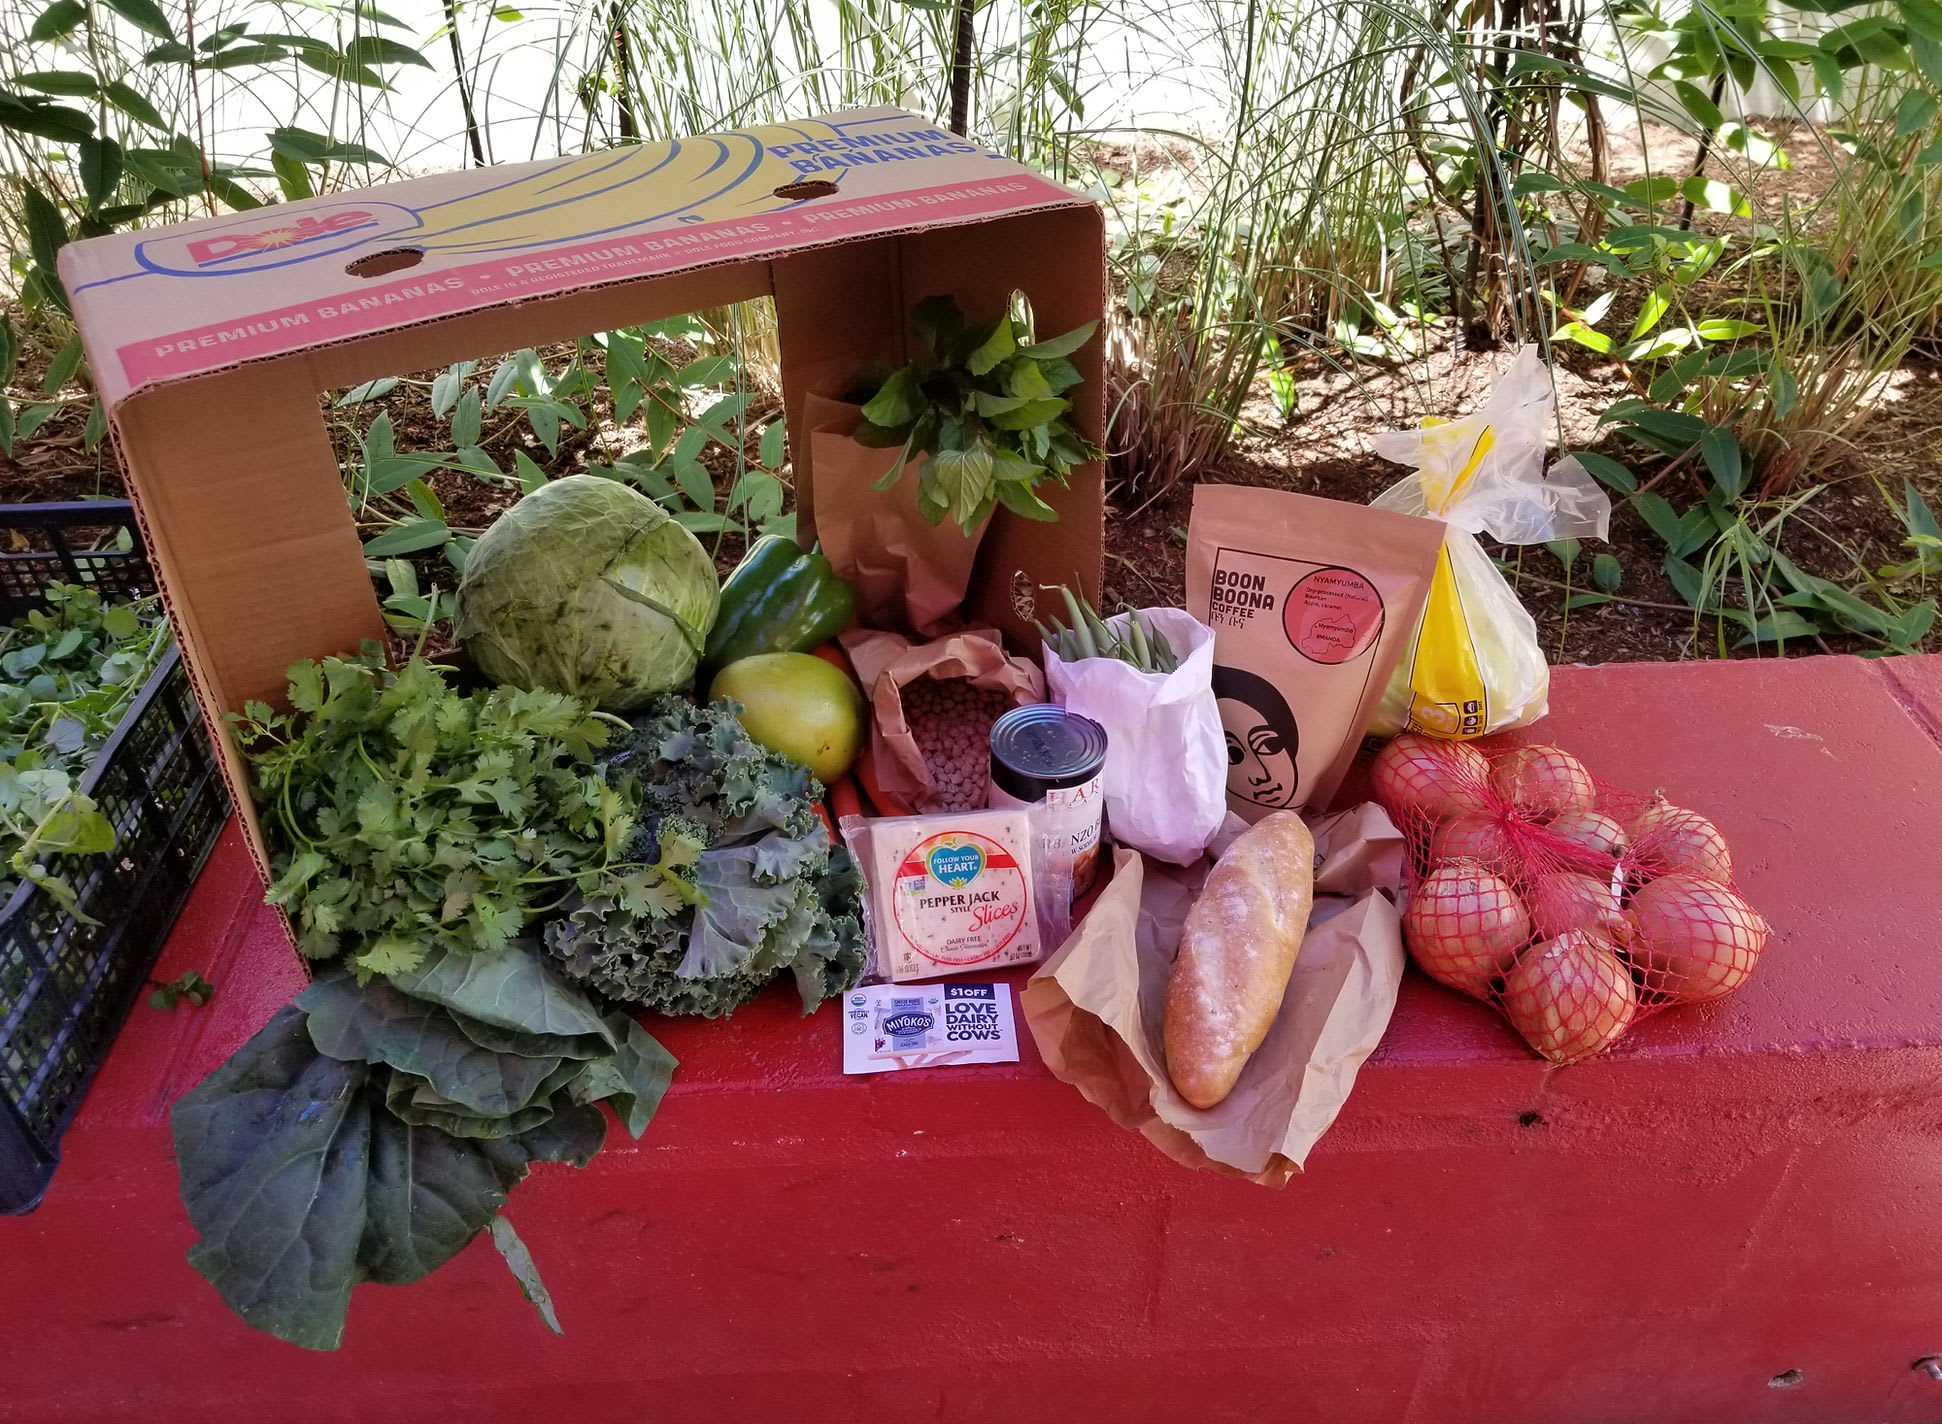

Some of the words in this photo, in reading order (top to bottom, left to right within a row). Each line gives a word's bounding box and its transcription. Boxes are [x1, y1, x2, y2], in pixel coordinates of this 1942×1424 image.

[767, 129, 948, 159] PREMIUM
[789, 141, 977, 174] BANANAS
[186, 211, 374, 264] Dole
[155, 312, 310, 358] PREMIUM
[318, 277, 465, 320] BANANAS
[505, 245, 640, 277] PREMIUM
[643, 223, 770, 251] BANANAS
[803, 199, 917, 224] PREMIUM
[921, 182, 1028, 206] BANANAS
[1215, 569, 1266, 591] BOON
[1313, 576, 1365, 590] NYAMYUMBA
[1213, 586, 1275, 610] BOONA
[1212, 601, 1255, 619] COFFEE
[933, 855, 959, 865] FOLLOW
[919, 894, 966, 909] PEPPER
[967, 890, 1000, 907] JACK
[968, 901, 1018, 932] Slices
[945, 1003, 997, 1014] LOVE
[946, 1013, 999, 1024] DAIRY
[946, 1023, 998, 1031] WITHOUT
